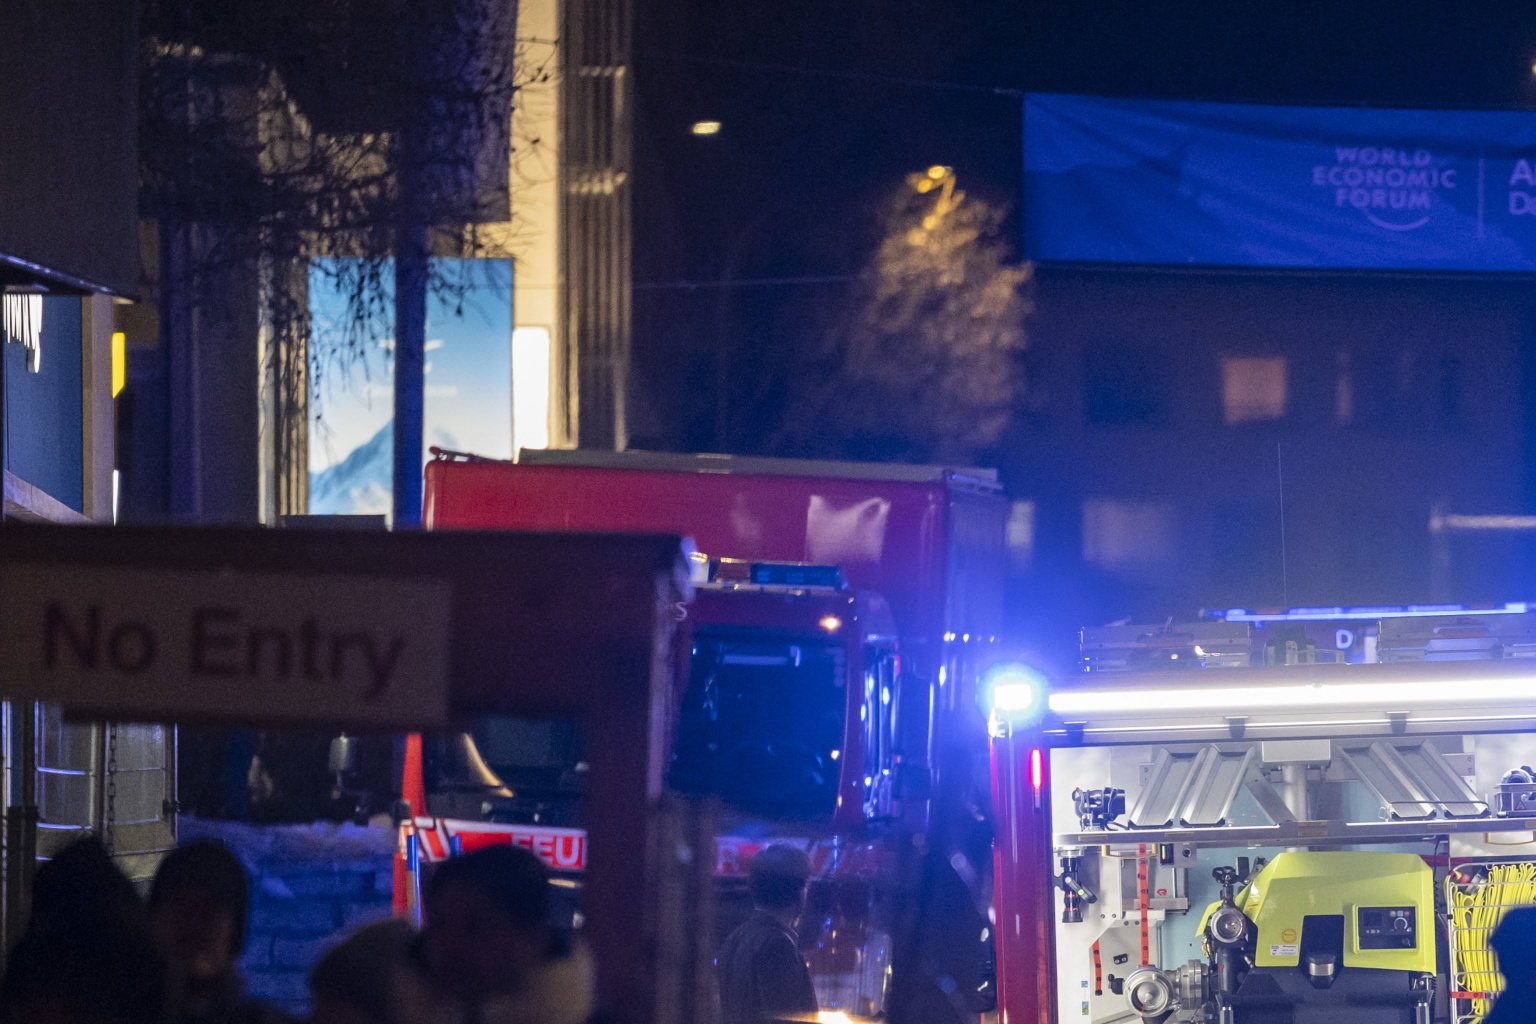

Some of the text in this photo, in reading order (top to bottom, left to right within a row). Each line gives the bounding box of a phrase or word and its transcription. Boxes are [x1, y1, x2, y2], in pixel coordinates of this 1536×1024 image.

[1334, 146, 1432, 167] WORLD
[1311, 165, 1457, 190] ECONOMIC
[1334, 188, 1432, 210] FORUM
[45, 602, 405, 701] No Entry
